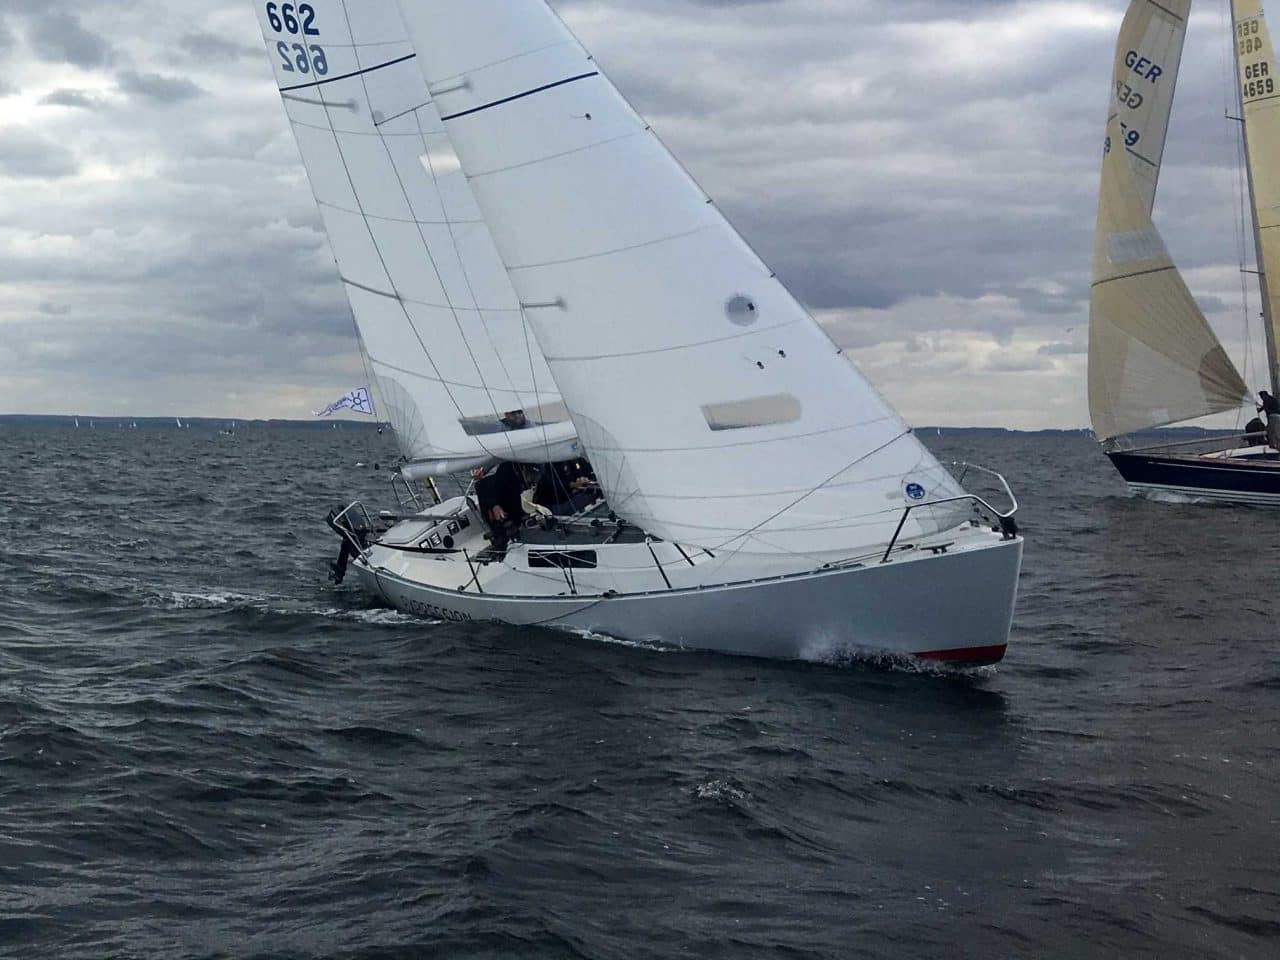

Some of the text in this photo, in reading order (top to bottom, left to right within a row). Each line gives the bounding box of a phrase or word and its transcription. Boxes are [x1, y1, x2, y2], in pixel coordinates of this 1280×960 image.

[265, 1, 320, 36] 662
[1124, 50, 1163, 84] GER
[1245, 61, 1269, 80] GER
